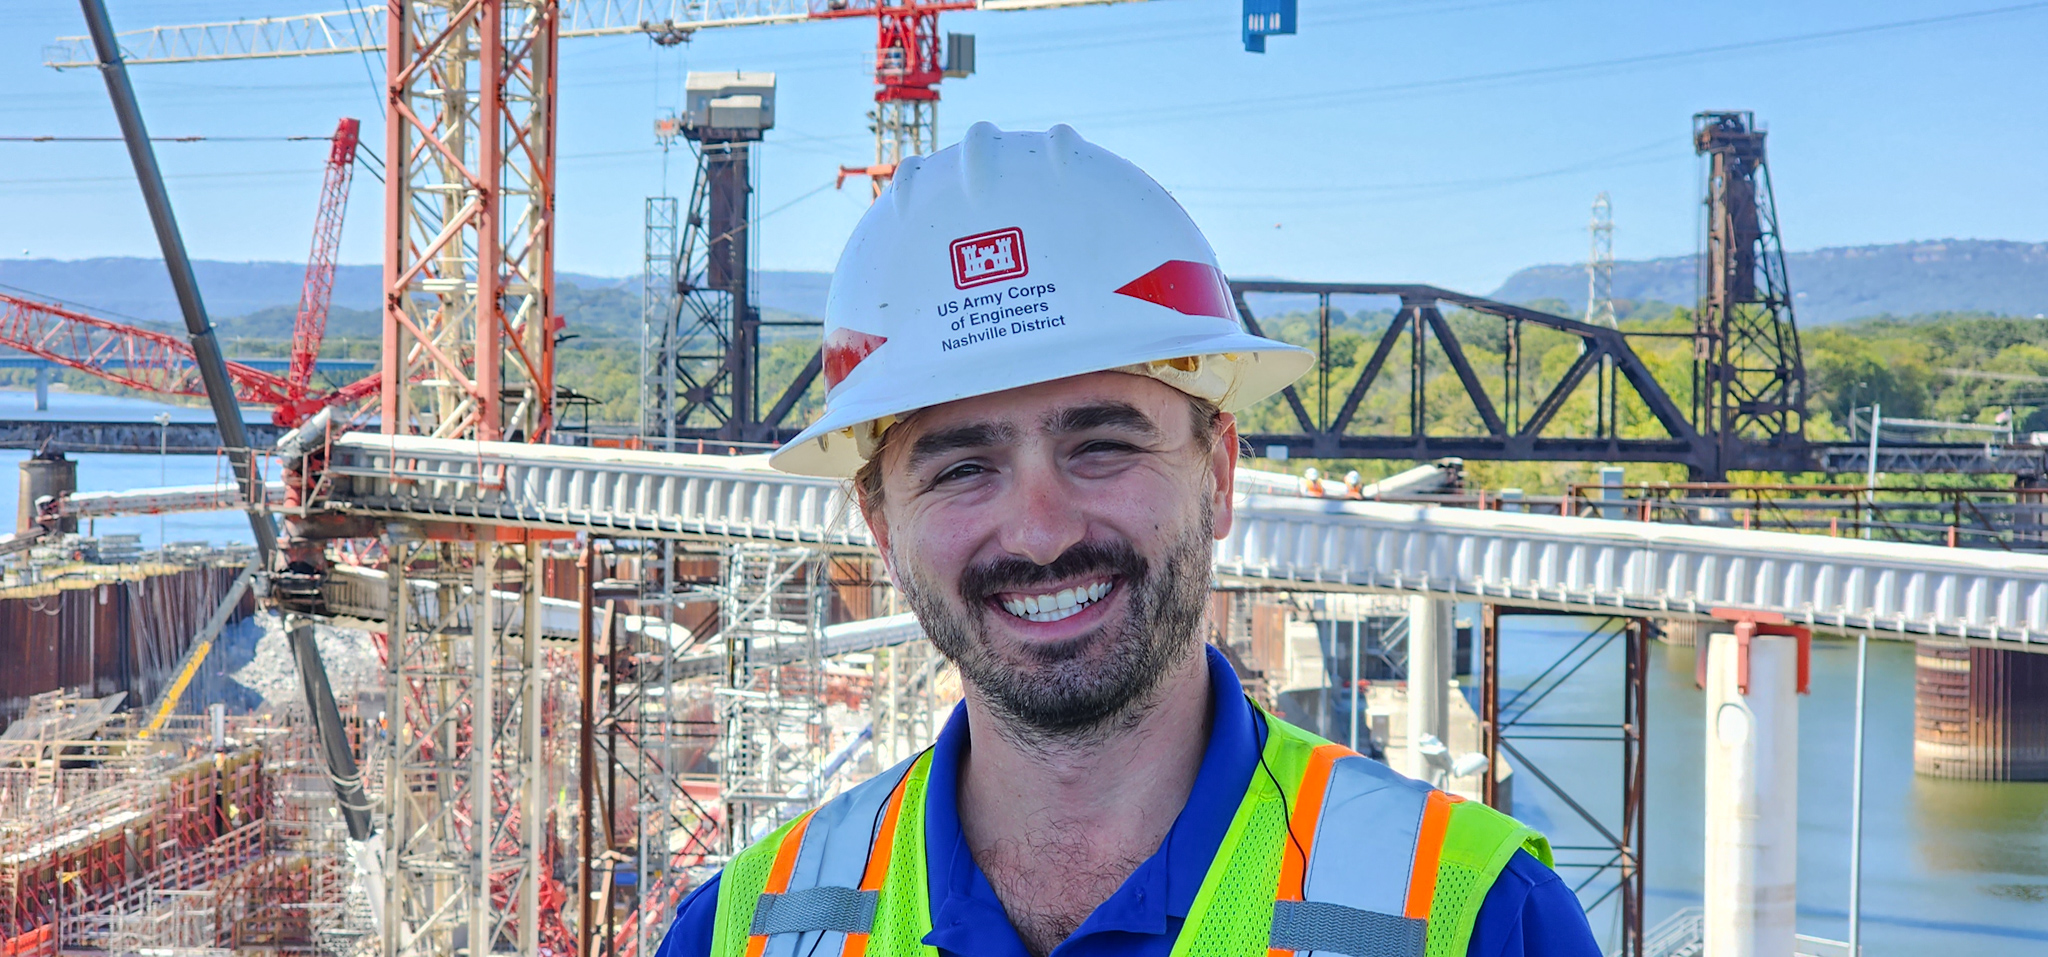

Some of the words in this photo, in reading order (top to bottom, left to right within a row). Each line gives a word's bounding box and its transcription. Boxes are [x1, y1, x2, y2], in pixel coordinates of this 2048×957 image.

[938, 301, 958, 317] US
[963, 292, 1002, 310] Army
[1008, 283, 1055, 299] Corps
[951, 317, 965, 330] of
[970, 302, 1049, 326] Engineers
[942, 327, 1007, 352] Nashville
[1011, 315, 1066, 334] District
